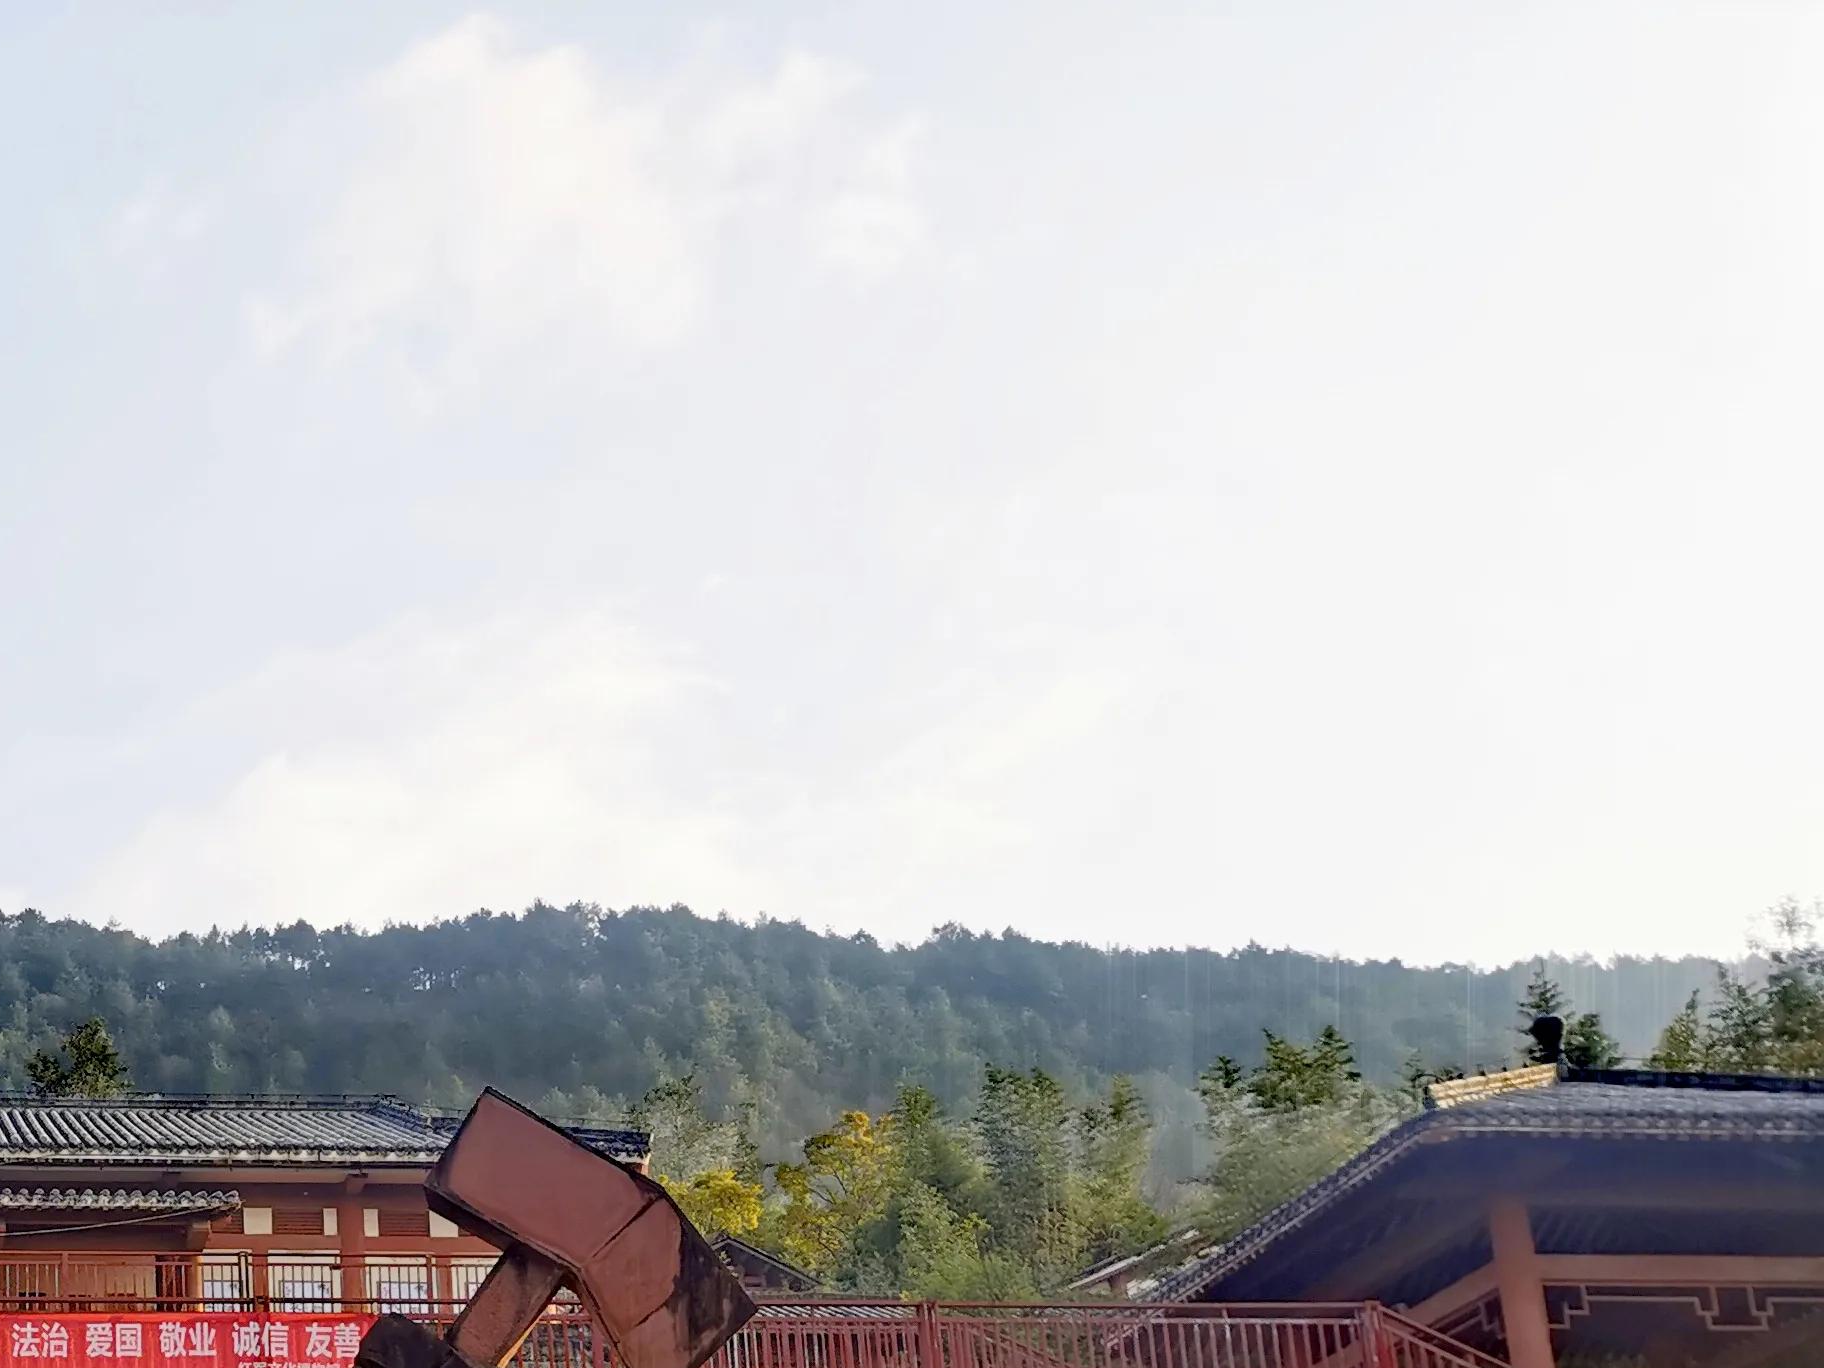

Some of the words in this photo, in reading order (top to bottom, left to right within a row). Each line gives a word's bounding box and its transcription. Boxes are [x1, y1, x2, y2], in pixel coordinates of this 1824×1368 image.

[11, 1322, 69, 1358] 法治
[85, 1322, 142, 1358] 爱国
[158, 1322, 216, 1357] 敬业
[232, 1322, 289, 1357] 诚信
[305, 1322, 362, 1357] 友善
